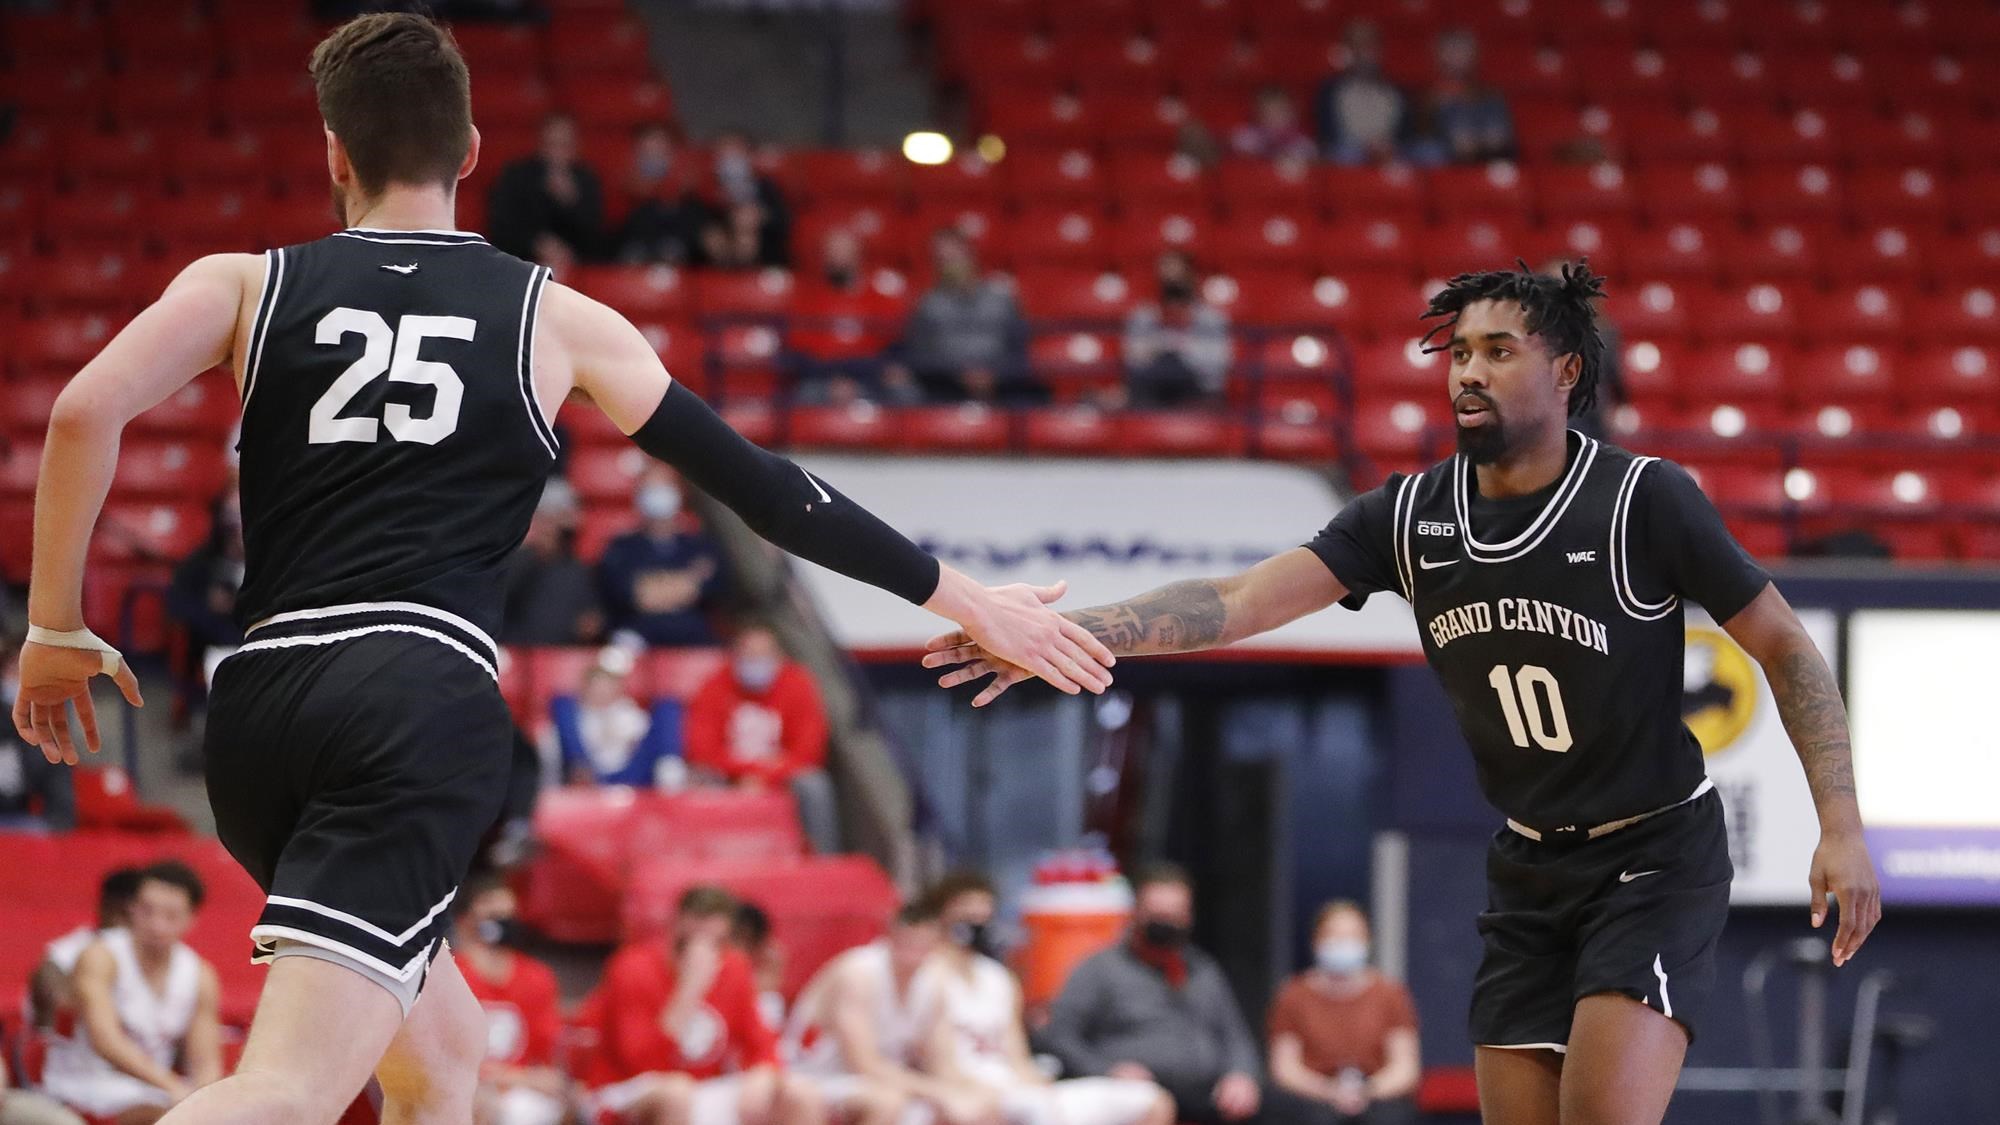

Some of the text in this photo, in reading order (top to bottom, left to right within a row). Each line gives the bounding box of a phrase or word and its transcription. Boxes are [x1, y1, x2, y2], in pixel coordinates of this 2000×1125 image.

[308, 307, 477, 446] 25
[1417, 524, 1455, 537] GOD
[1565, 550, 1596, 563] WAC
[1428, 598, 1609, 656] GRAND CANYON
[1488, 664, 1574, 753] 10
